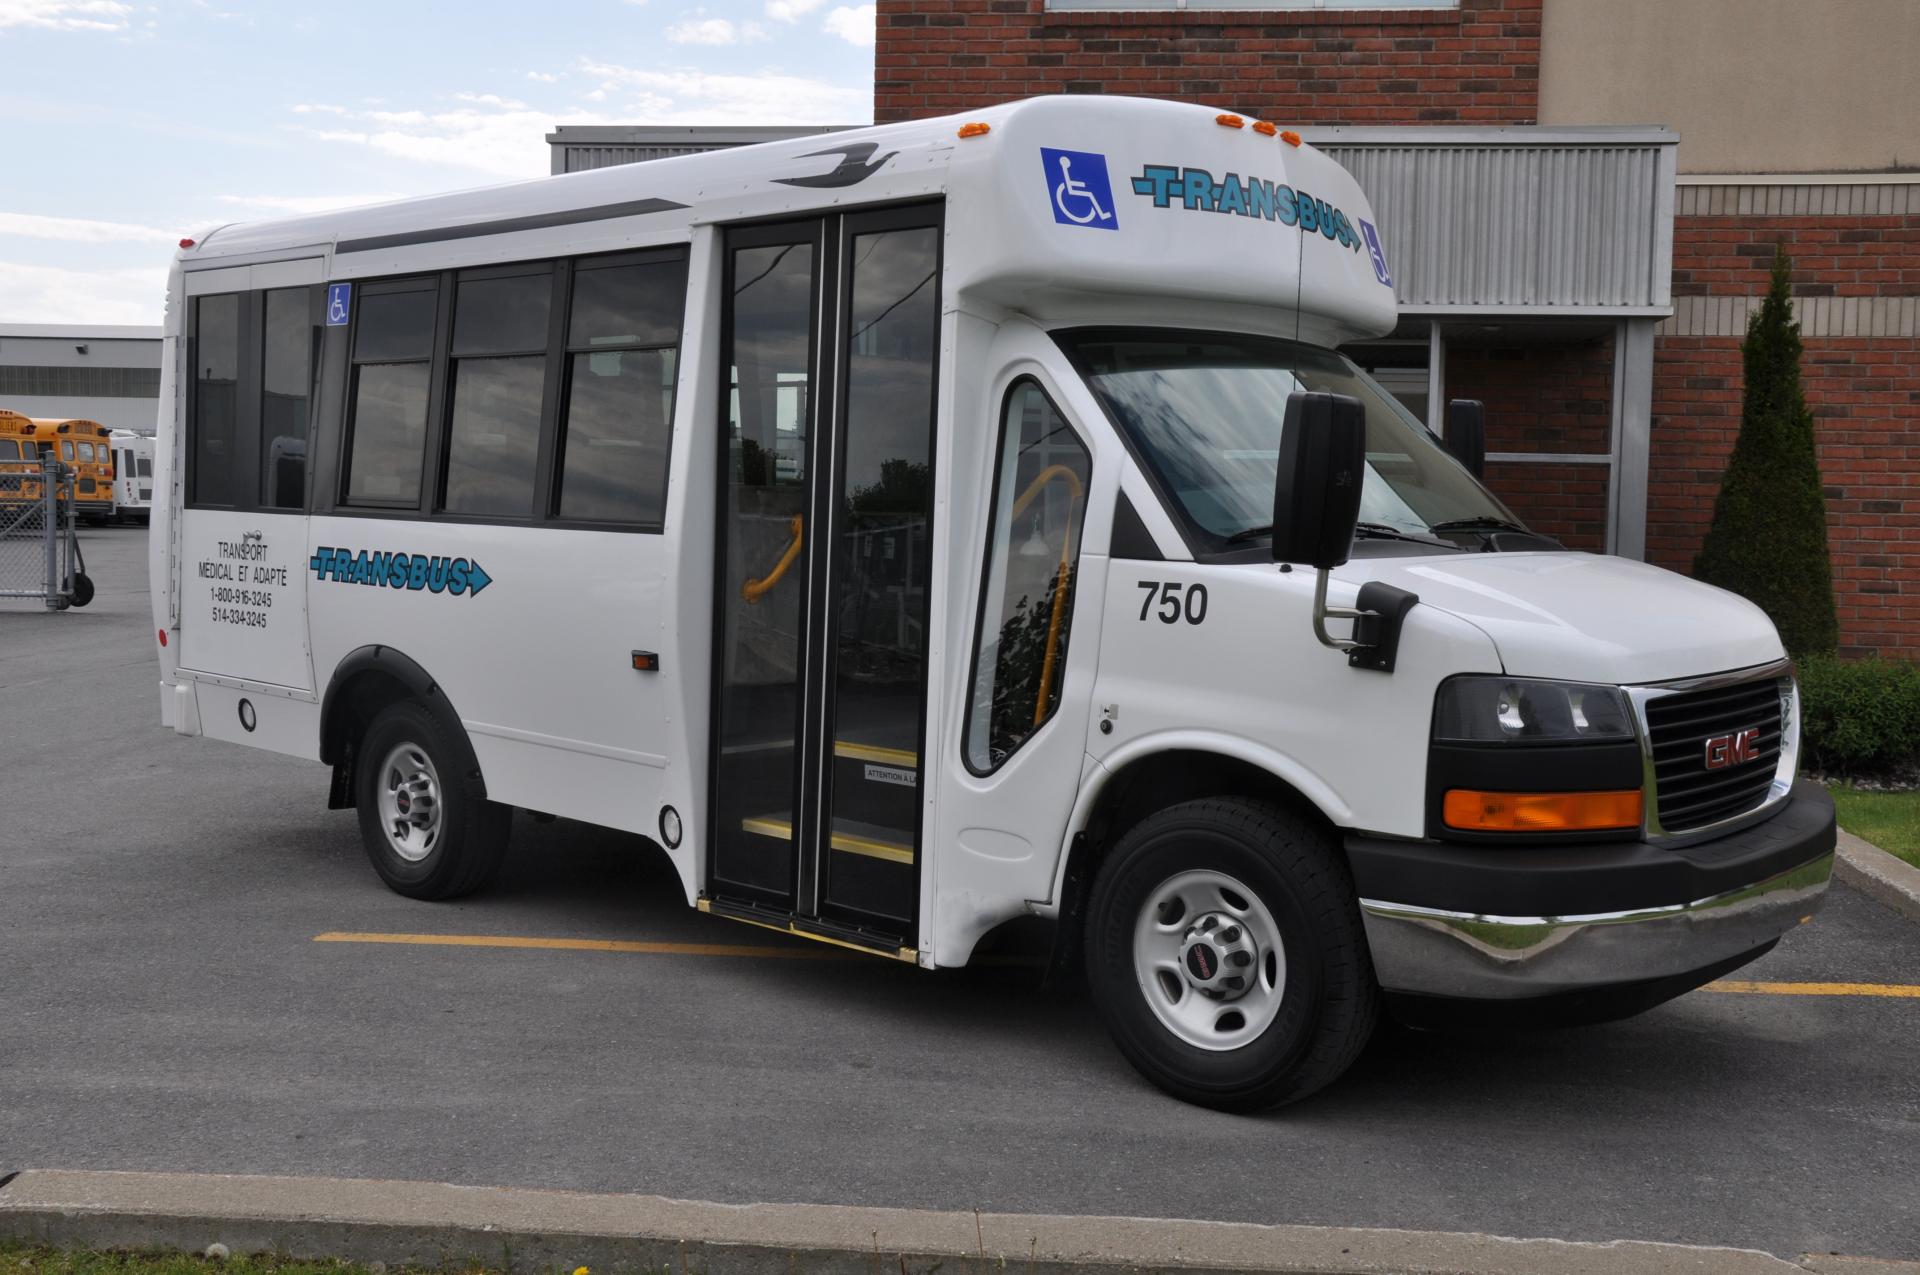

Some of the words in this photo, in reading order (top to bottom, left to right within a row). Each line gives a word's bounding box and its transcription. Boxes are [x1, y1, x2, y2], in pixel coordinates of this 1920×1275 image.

[1141, 163, 1355, 249] TRANSBUS
[218, 541, 268, 562] TRANSPORT
[198, 557, 234, 581] MÉDICAL
[237, 565, 249, 582] ET
[252, 564, 288, 587] ADAPTÉ
[313, 546, 471, 596] TRANSBUS
[210, 587, 272, 608] 1-800-916-3245
[1137, 580, 1208, 625] 750
[211, 607, 267, 628] 514-334-3245
[1705, 727, 1760, 770] GMC
[868, 769, 902, 781] ATTENTION
